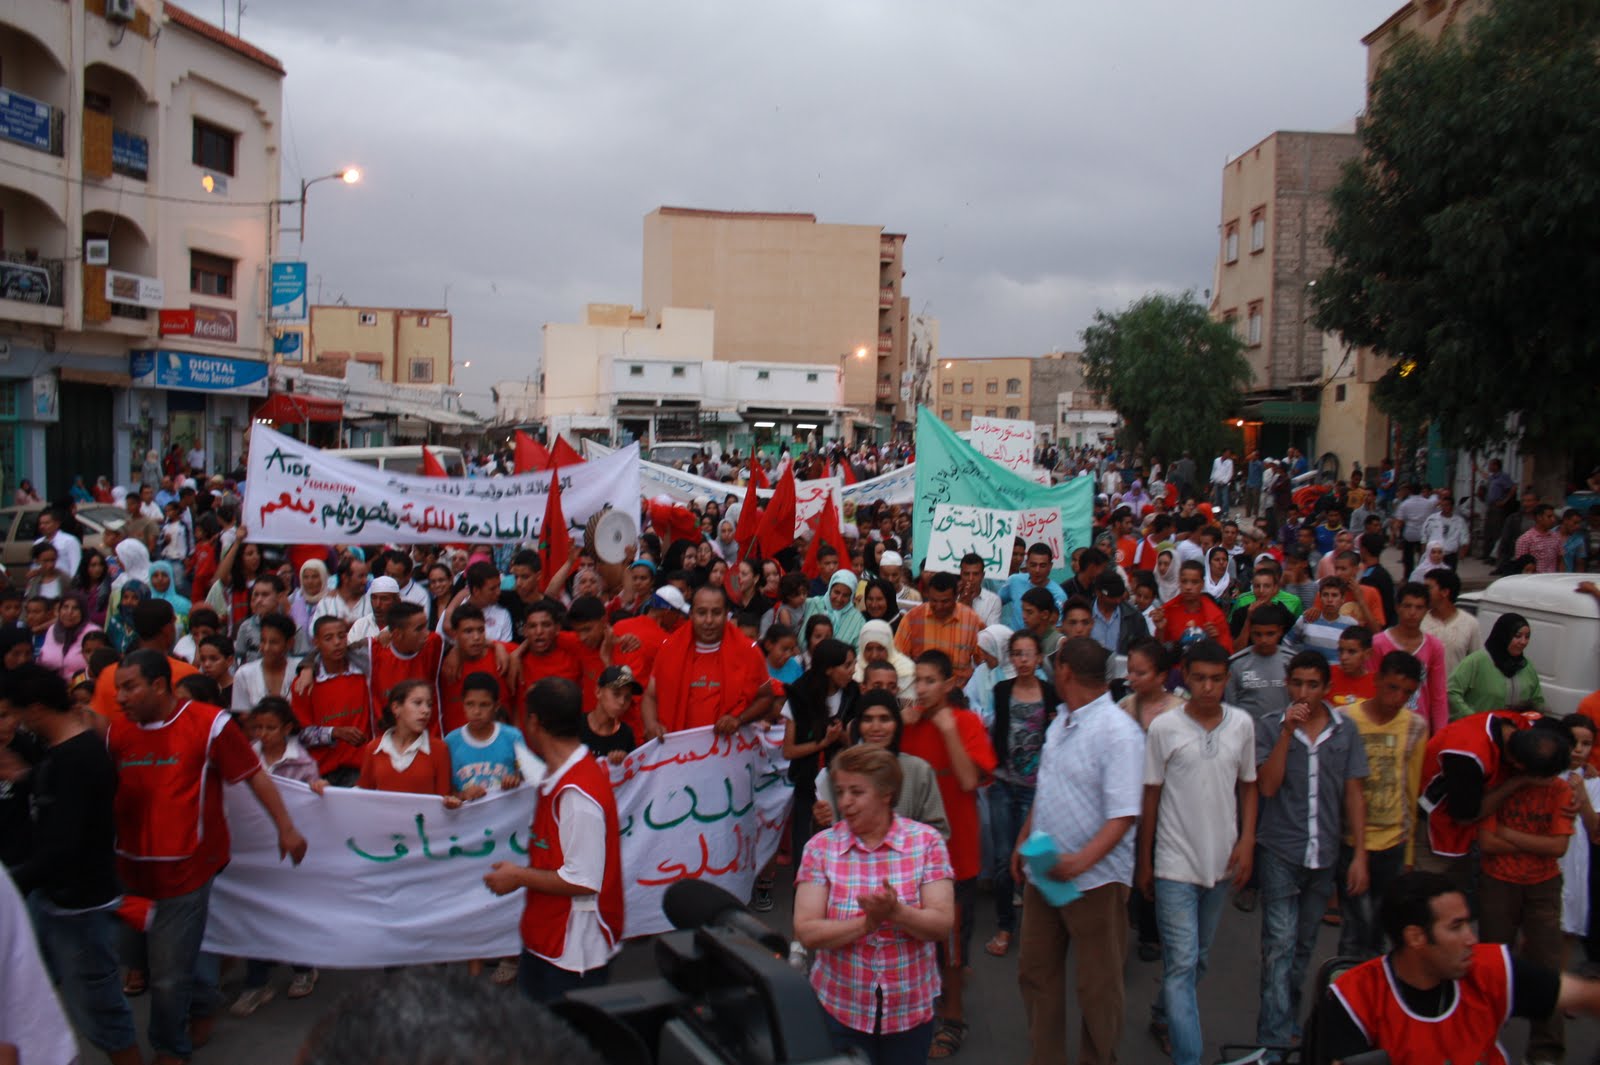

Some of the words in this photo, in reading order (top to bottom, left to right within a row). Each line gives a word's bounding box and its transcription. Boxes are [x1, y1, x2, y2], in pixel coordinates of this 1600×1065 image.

[189, 359, 236, 374] DIGITAL
[191, 369, 210, 382] Photo
[211, 371, 235, 385] Service
[304, 479, 357, 495] FEDERATION
[260, 486, 318, 529] بنعم
[321, 494, 401, 535] بتصويتهم
[457, 509, 529, 539] المبادرة
[934, 506, 994, 540] للدستور
[988, 517, 1013, 543] نعم
